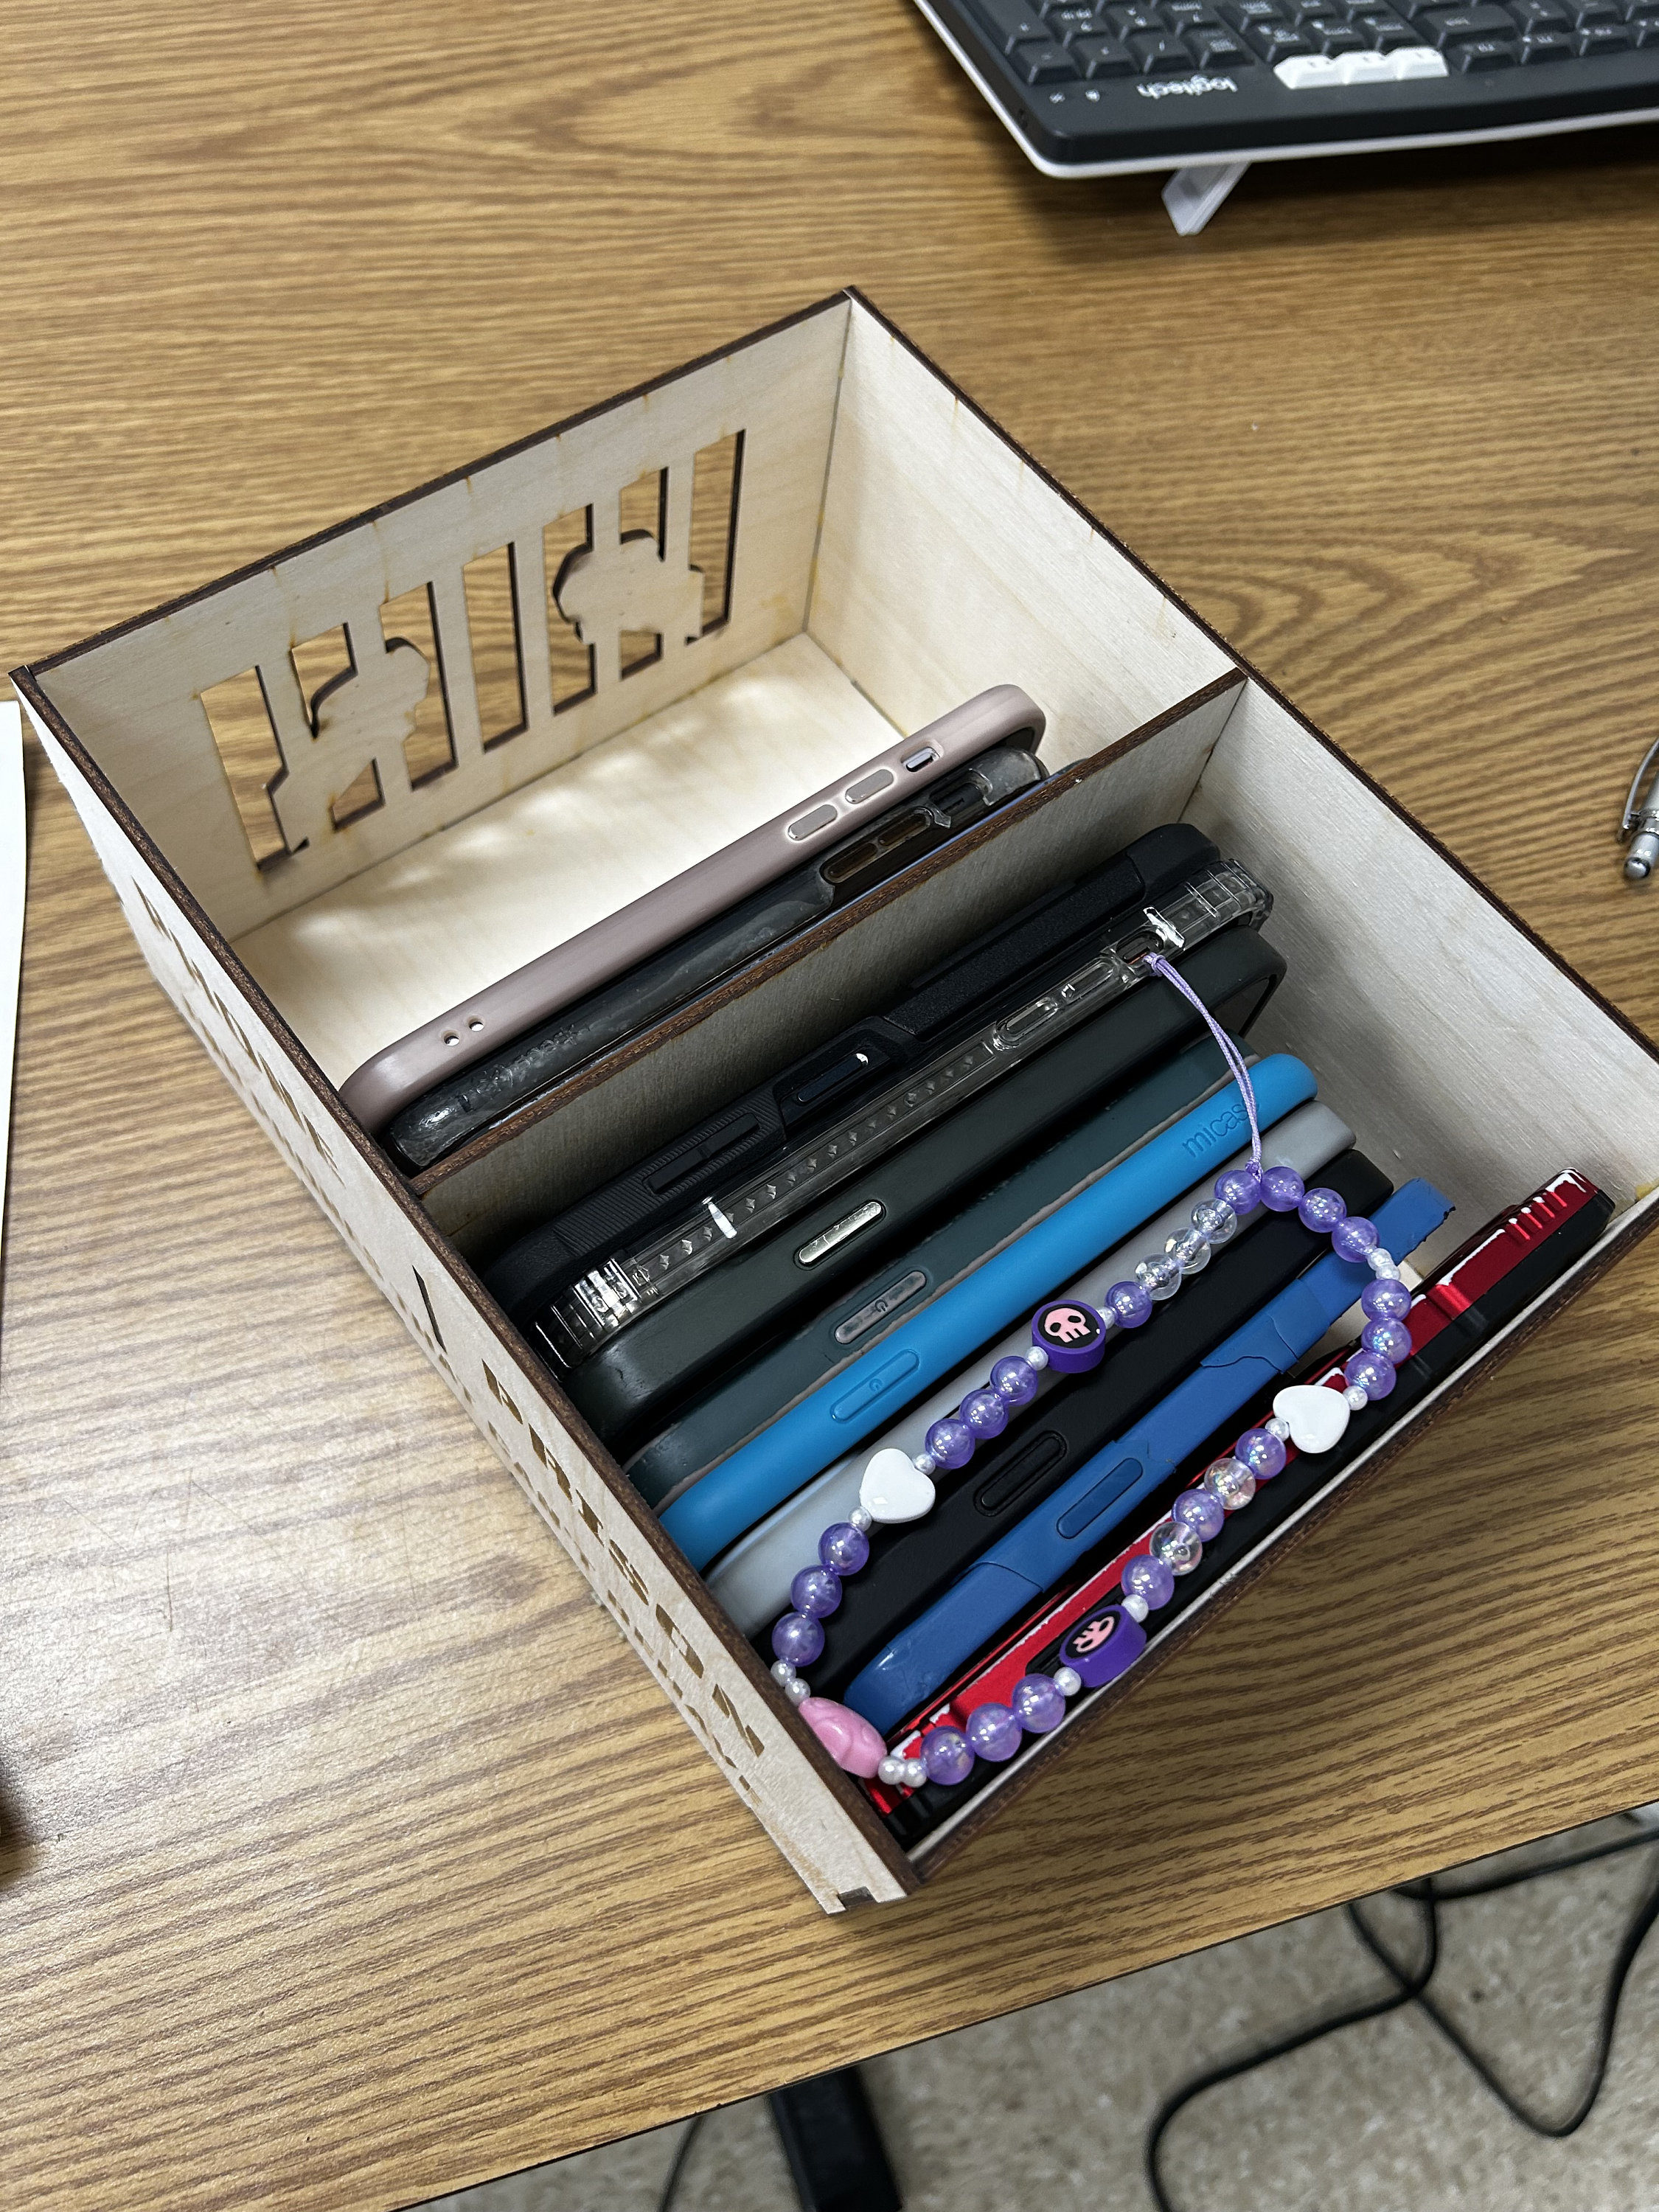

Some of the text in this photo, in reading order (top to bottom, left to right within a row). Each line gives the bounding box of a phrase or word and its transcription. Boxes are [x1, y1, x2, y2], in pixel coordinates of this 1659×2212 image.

[1136, 74, 1238, 100] logitech
[1182, 1099, 1259, 1158] micas
[481, 1359, 764, 1757] PRISON
[608, 1589, 762, 1806] BEHAVE
